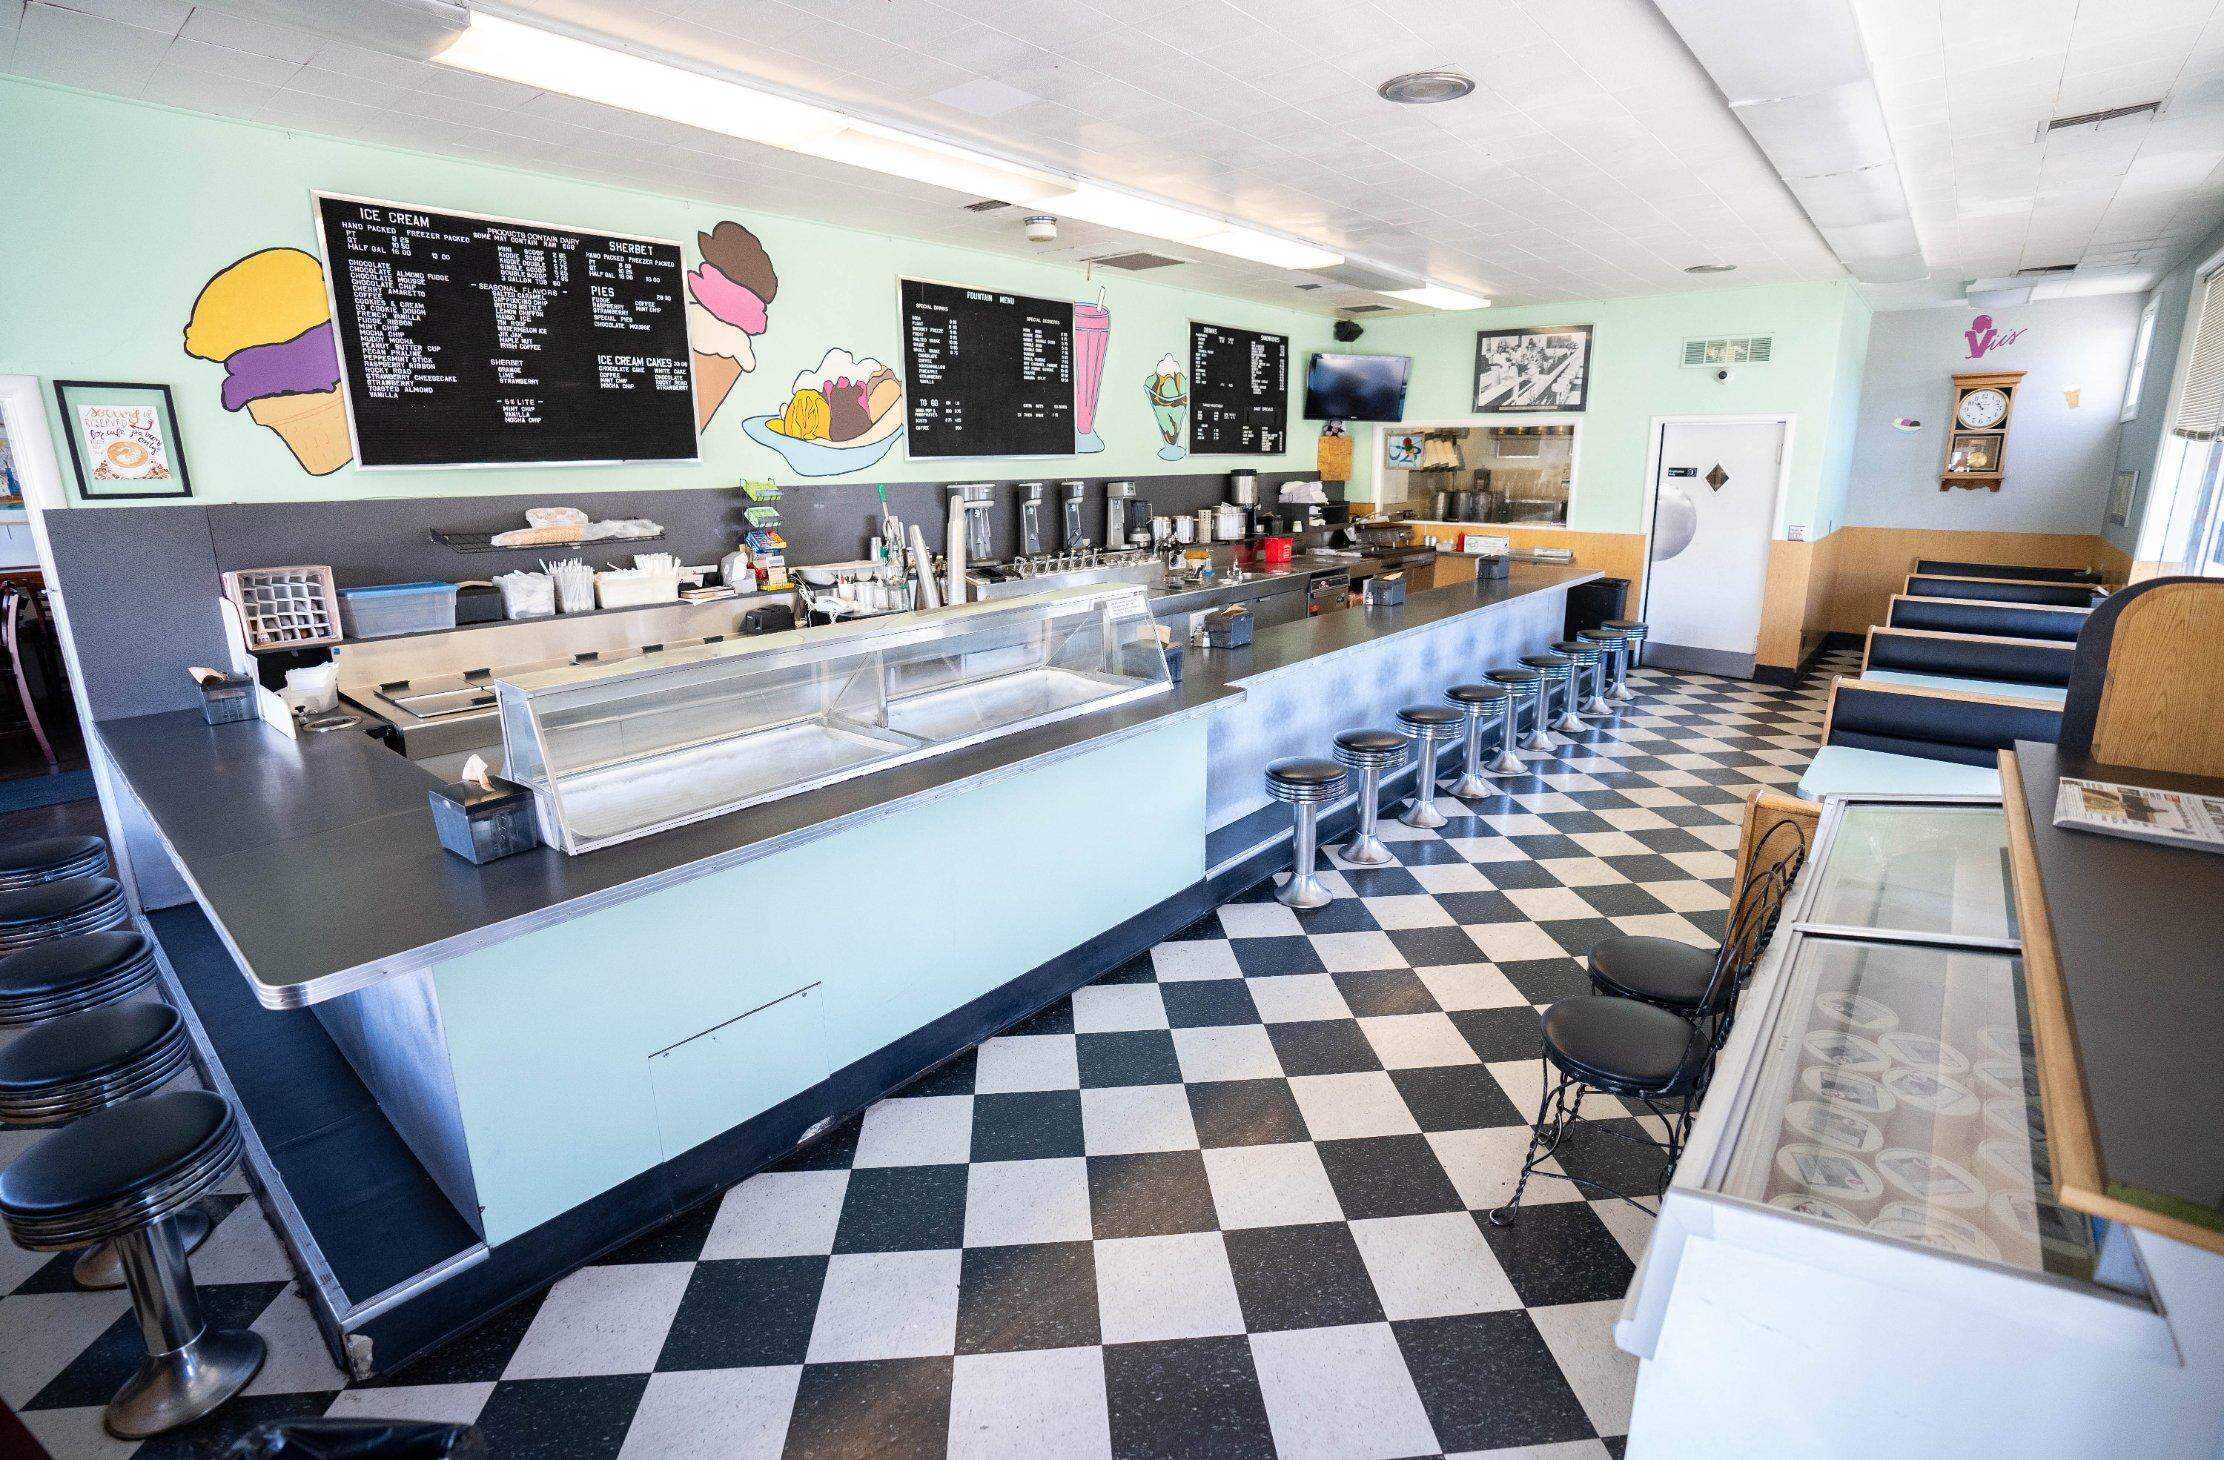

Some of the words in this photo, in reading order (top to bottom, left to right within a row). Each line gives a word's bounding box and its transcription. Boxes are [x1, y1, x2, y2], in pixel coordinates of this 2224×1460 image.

[360, 208, 381, 221] ICE
[388, 212, 430, 228] CREAM
[342, 221, 363, 230] HAND
[367, 224, 397, 234] PACKED
[406, 229, 440, 239] FREEZER
[443, 234, 470, 243] PACKED
[609, 241, 653, 256] SHERBET
[348, 259, 391, 269] CHOCOLATE
[349, 266, 392, 276] CHOCOLATE
[350, 272, 394, 282] CHOCOLATE
[351, 278, 394, 288] CHOCOLATE
[479, 283, 517, 293] SEASONAL
[522, 287, 558, 297] FLAVORS
[591, 285, 614, 297] PIES
[1000, 294, 1015, 305] MENU
[598, 355, 613, 365] ICE
[615, 356, 644, 366] CREAM
[646, 357, 672, 368] CAKES
